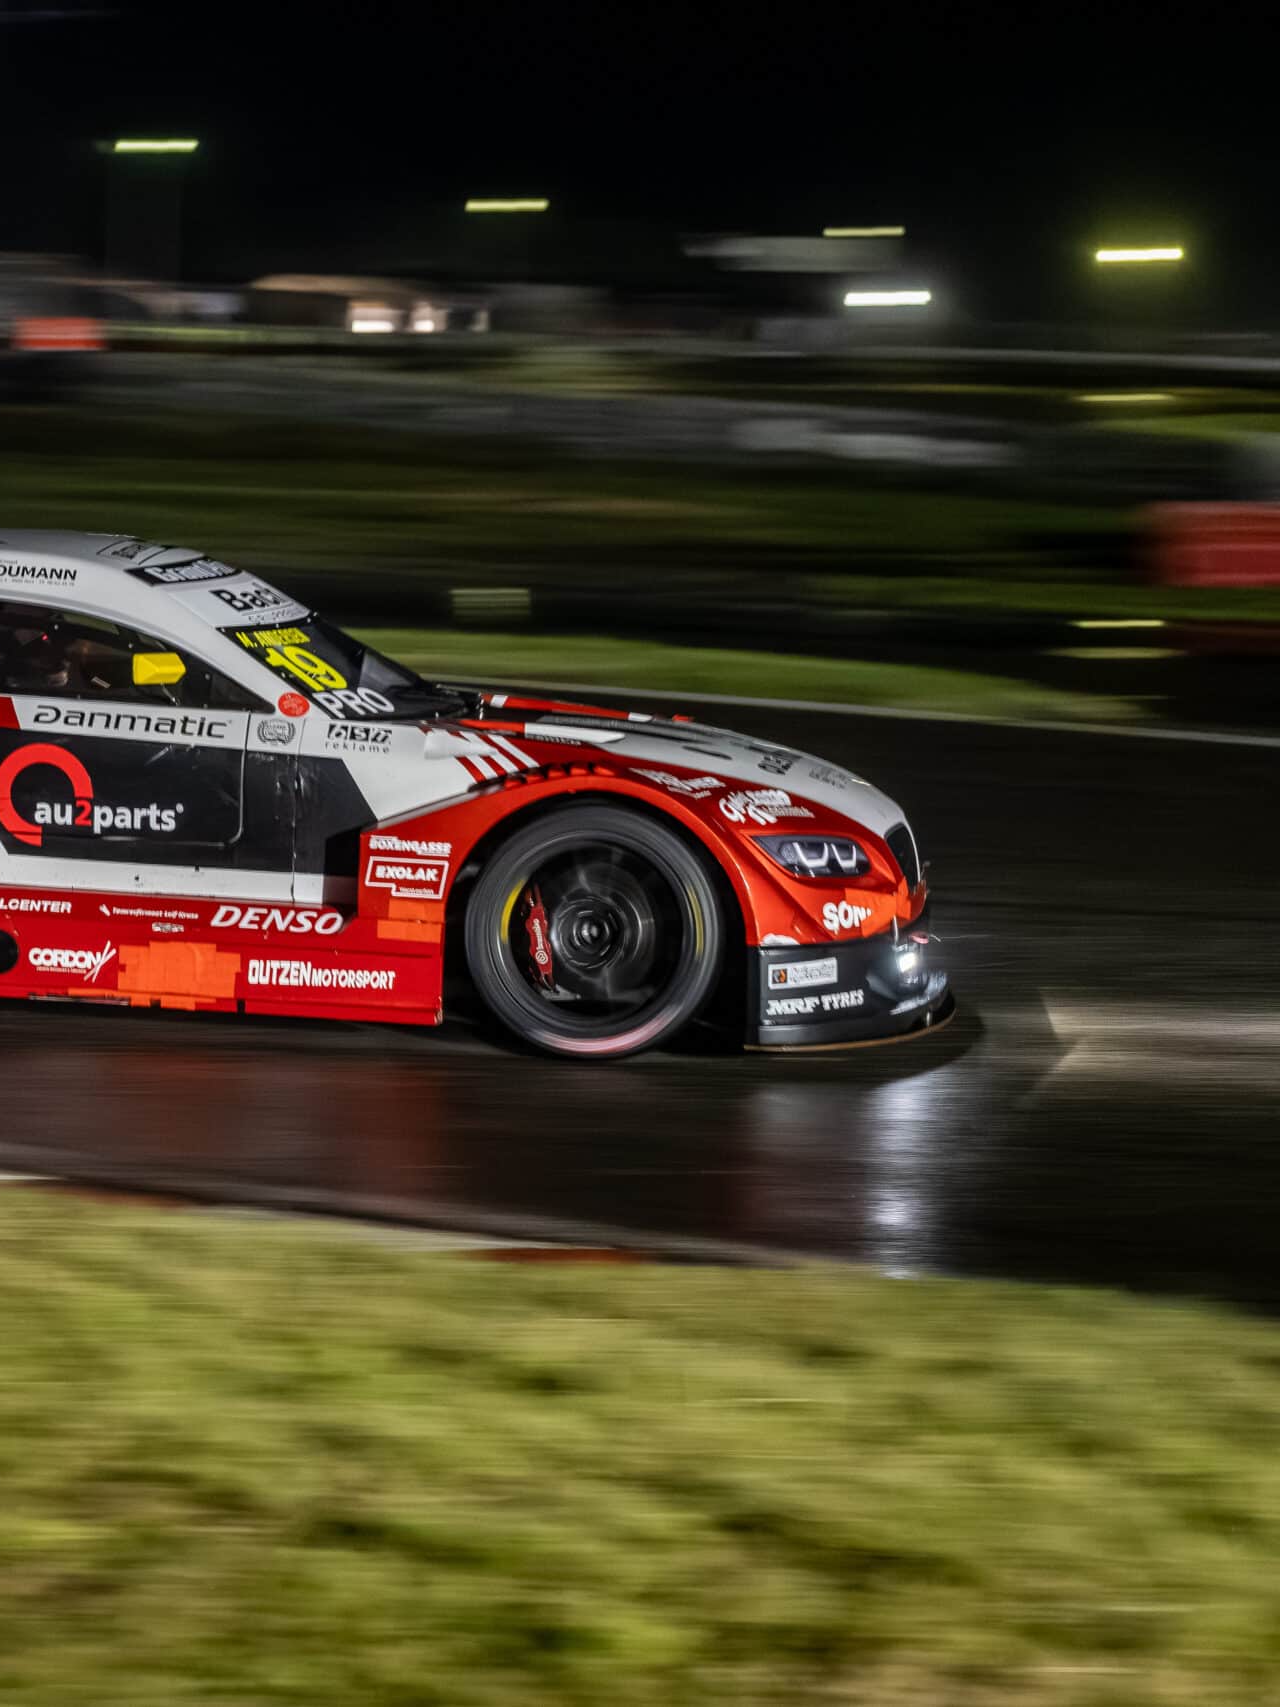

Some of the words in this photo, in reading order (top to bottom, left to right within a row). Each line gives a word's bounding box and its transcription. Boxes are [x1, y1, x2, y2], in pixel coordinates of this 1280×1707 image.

[266, 645, 347, 691] 19
[312, 687, 394, 719] PRO
[33, 705, 228, 738] Danmatic
[325, 742, 390, 752] reklame
[34, 799, 178, 834] au2parts
[369, 835, 452, 856] BOXENGASSE
[376, 865, 438, 881] EXOLAK
[210, 905, 345, 935] DENSO
[766, 996, 820, 1015] MRF
[821, 989, 865, 1010] TYRES
